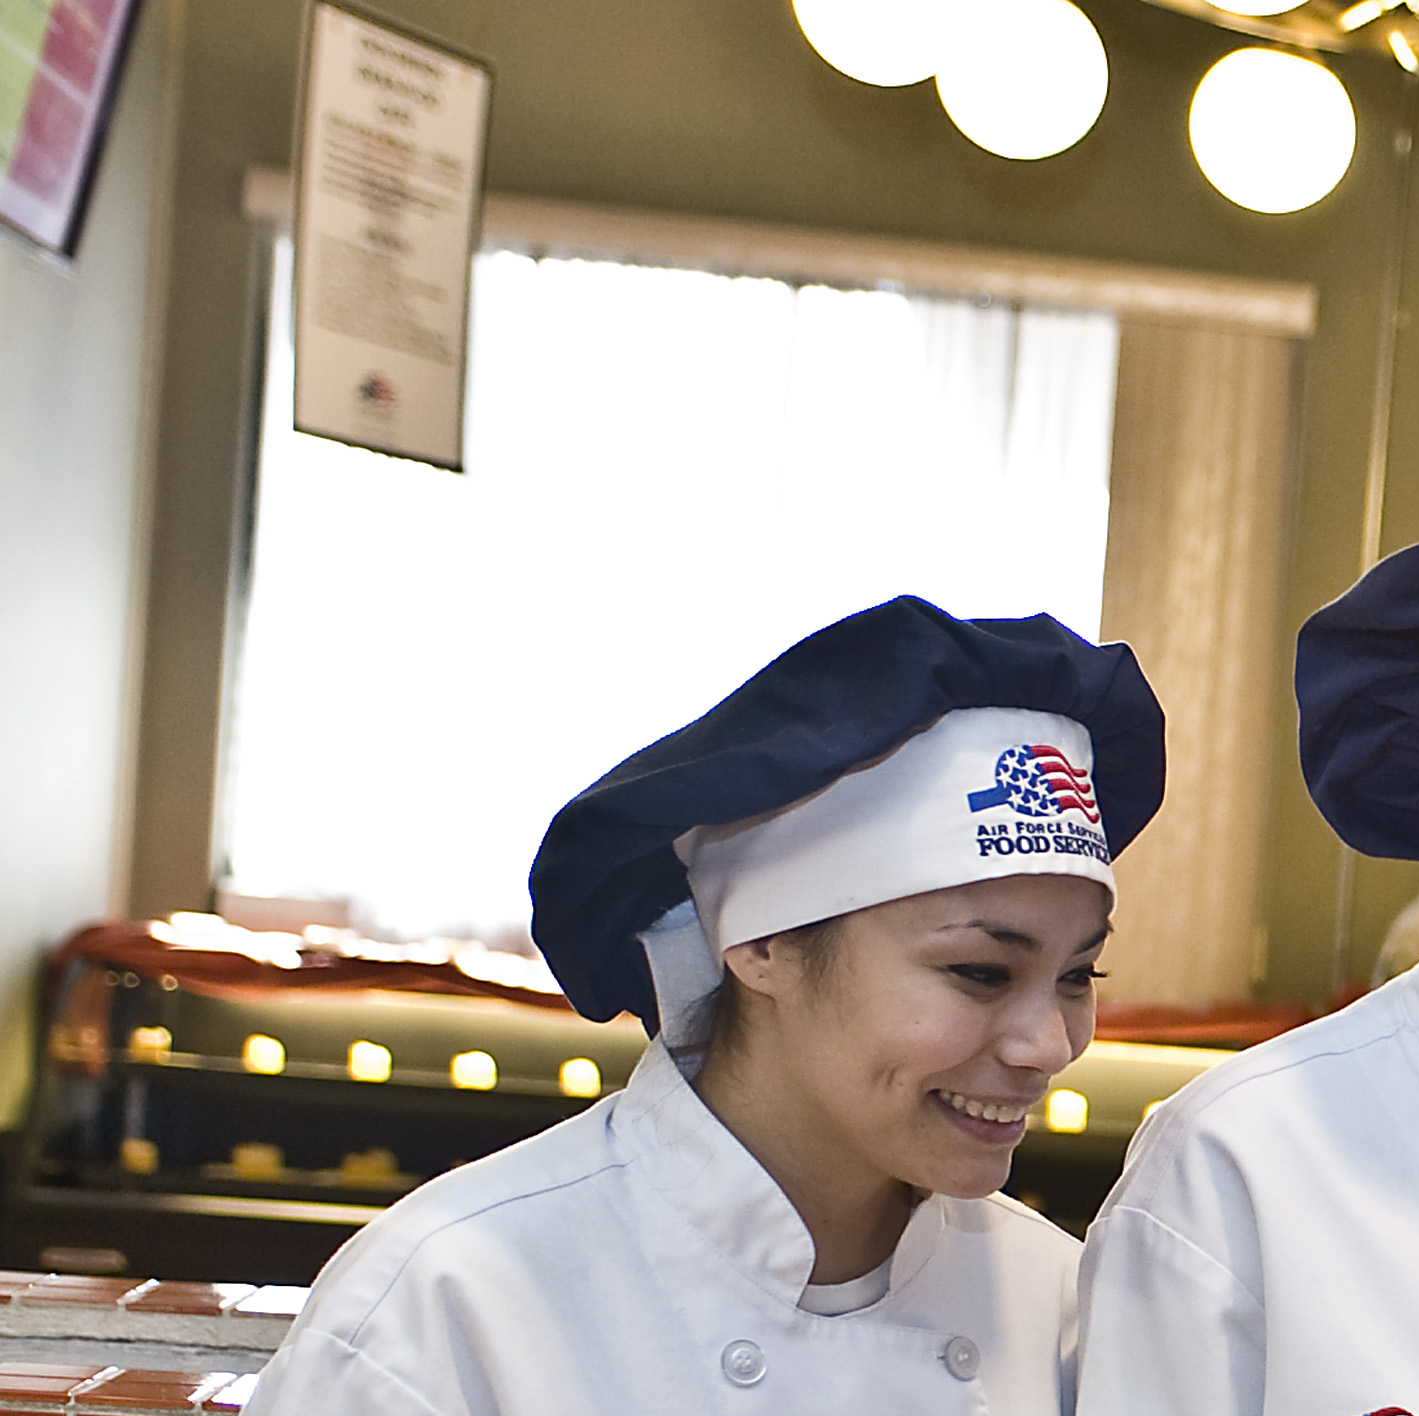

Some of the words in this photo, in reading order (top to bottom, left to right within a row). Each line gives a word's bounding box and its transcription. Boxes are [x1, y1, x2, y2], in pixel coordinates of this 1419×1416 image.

[977, 824, 1008, 837] AIR
[1015, 822, 1063, 834] FORCE
[976, 836, 1051, 857] FOOD
